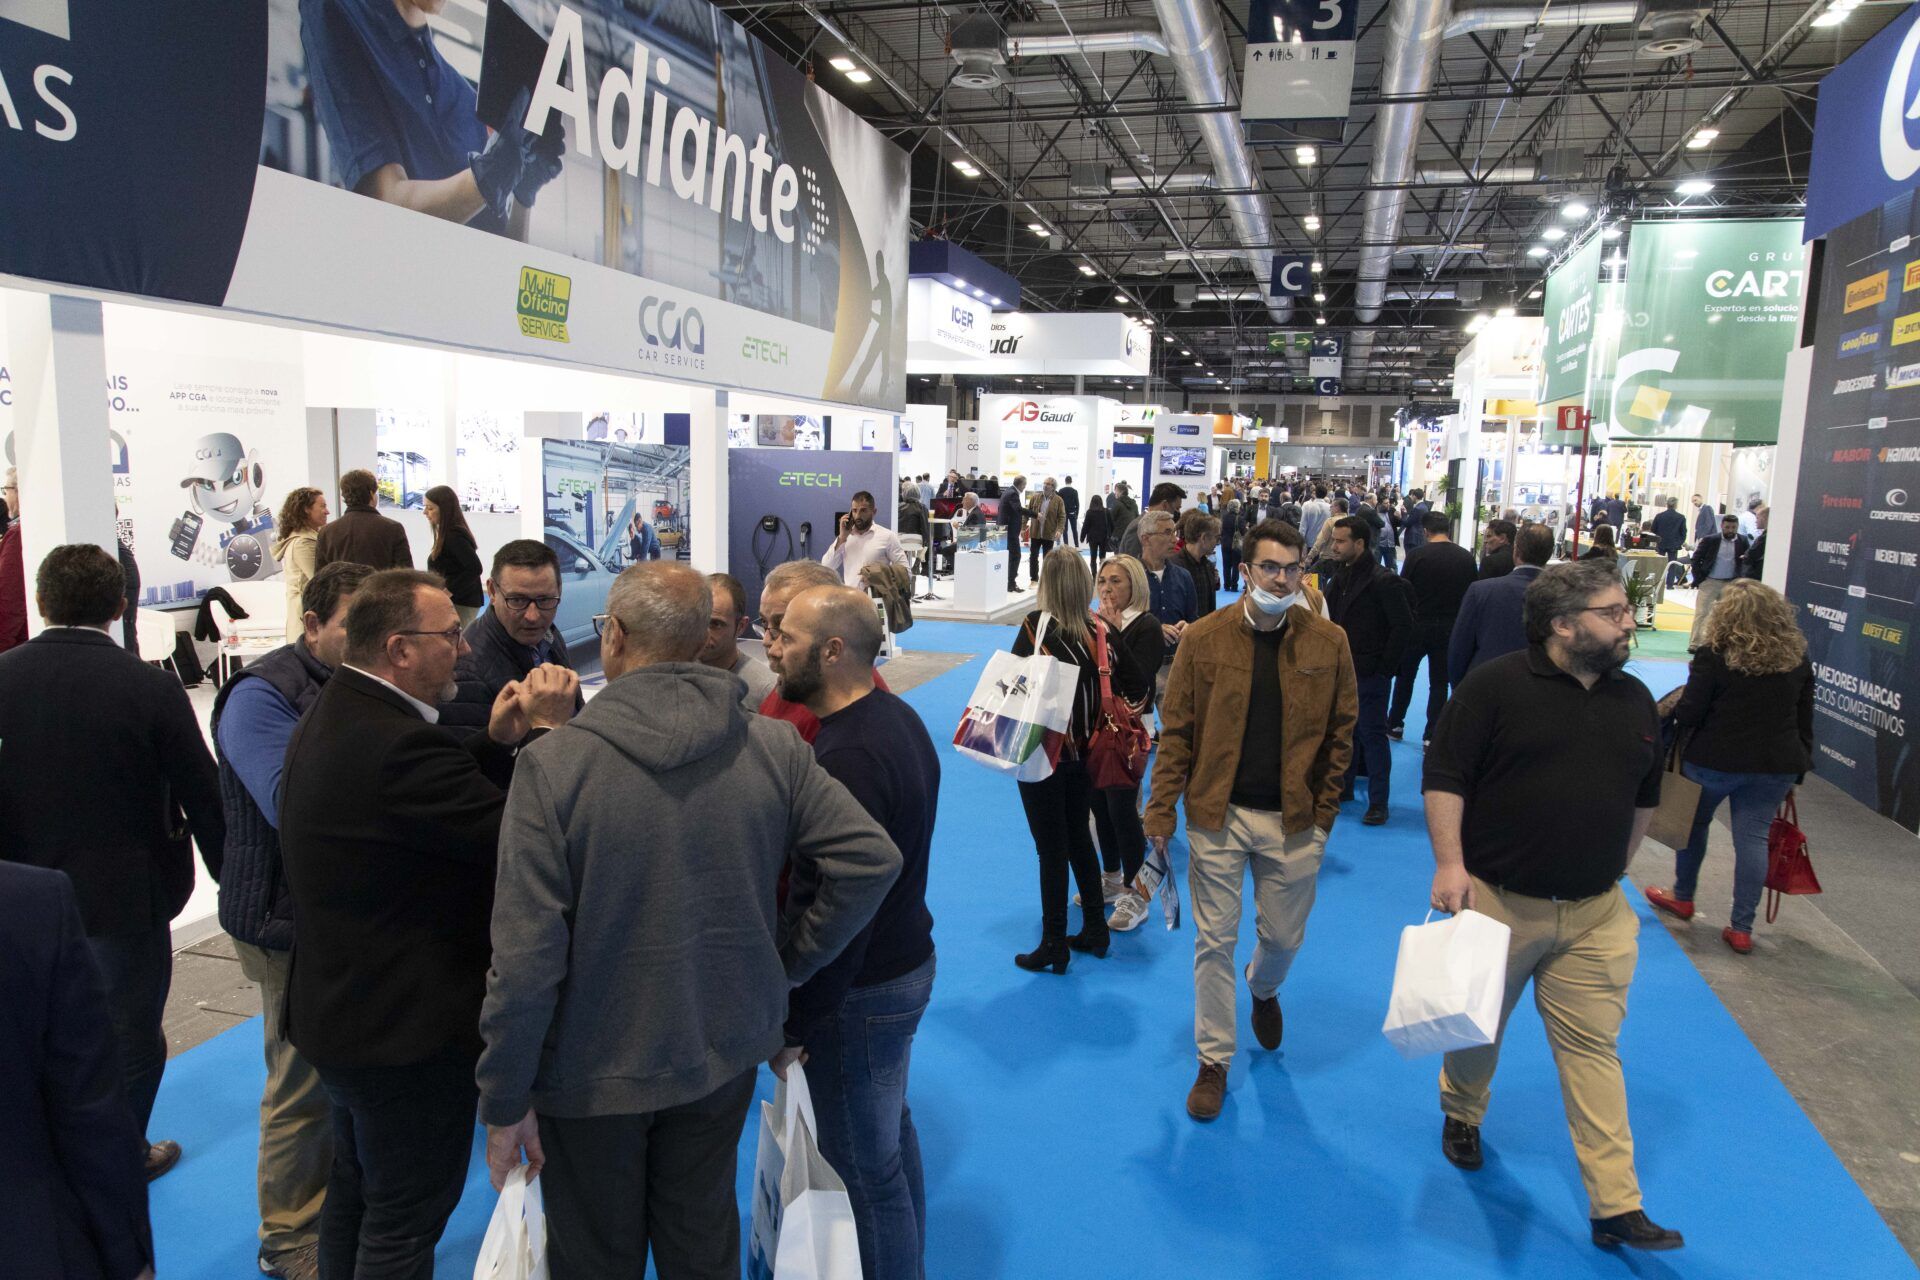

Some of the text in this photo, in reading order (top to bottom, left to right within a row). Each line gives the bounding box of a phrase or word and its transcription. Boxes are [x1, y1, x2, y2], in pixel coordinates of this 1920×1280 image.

[523, 4, 799, 243] Adiante
[524, 271, 555, 295] Multi
[1280, 261, 1304, 291] C
[520, 291, 566, 316] Oficina
[1704, 304, 1747, 313] Expertos
[951, 304, 974, 329] ICER
[1736, 314, 1767, 323] desde
[1768, 314, 1777, 322] la
[522, 317, 565, 340] SERVICE
[638, 347, 705, 370] CAR SERVICE
[1328, 340, 1338, 355] 3
[169, 391, 187, 400] APP
[188, 392, 208, 402] CGA
[260, 388, 279, 396] nova
[1320, 379, 1332, 394] C
[1002, 401, 1040, 422] AG
[1875, 548, 1918, 567] NEXEN TIRE
[1862, 622, 1883, 639] WEST
[1818, 663, 1858, 693] MEJORES
[1859, 679, 1902, 711] MARCAS
[1837, 692, 1905, 738] COMPETITIVOS
